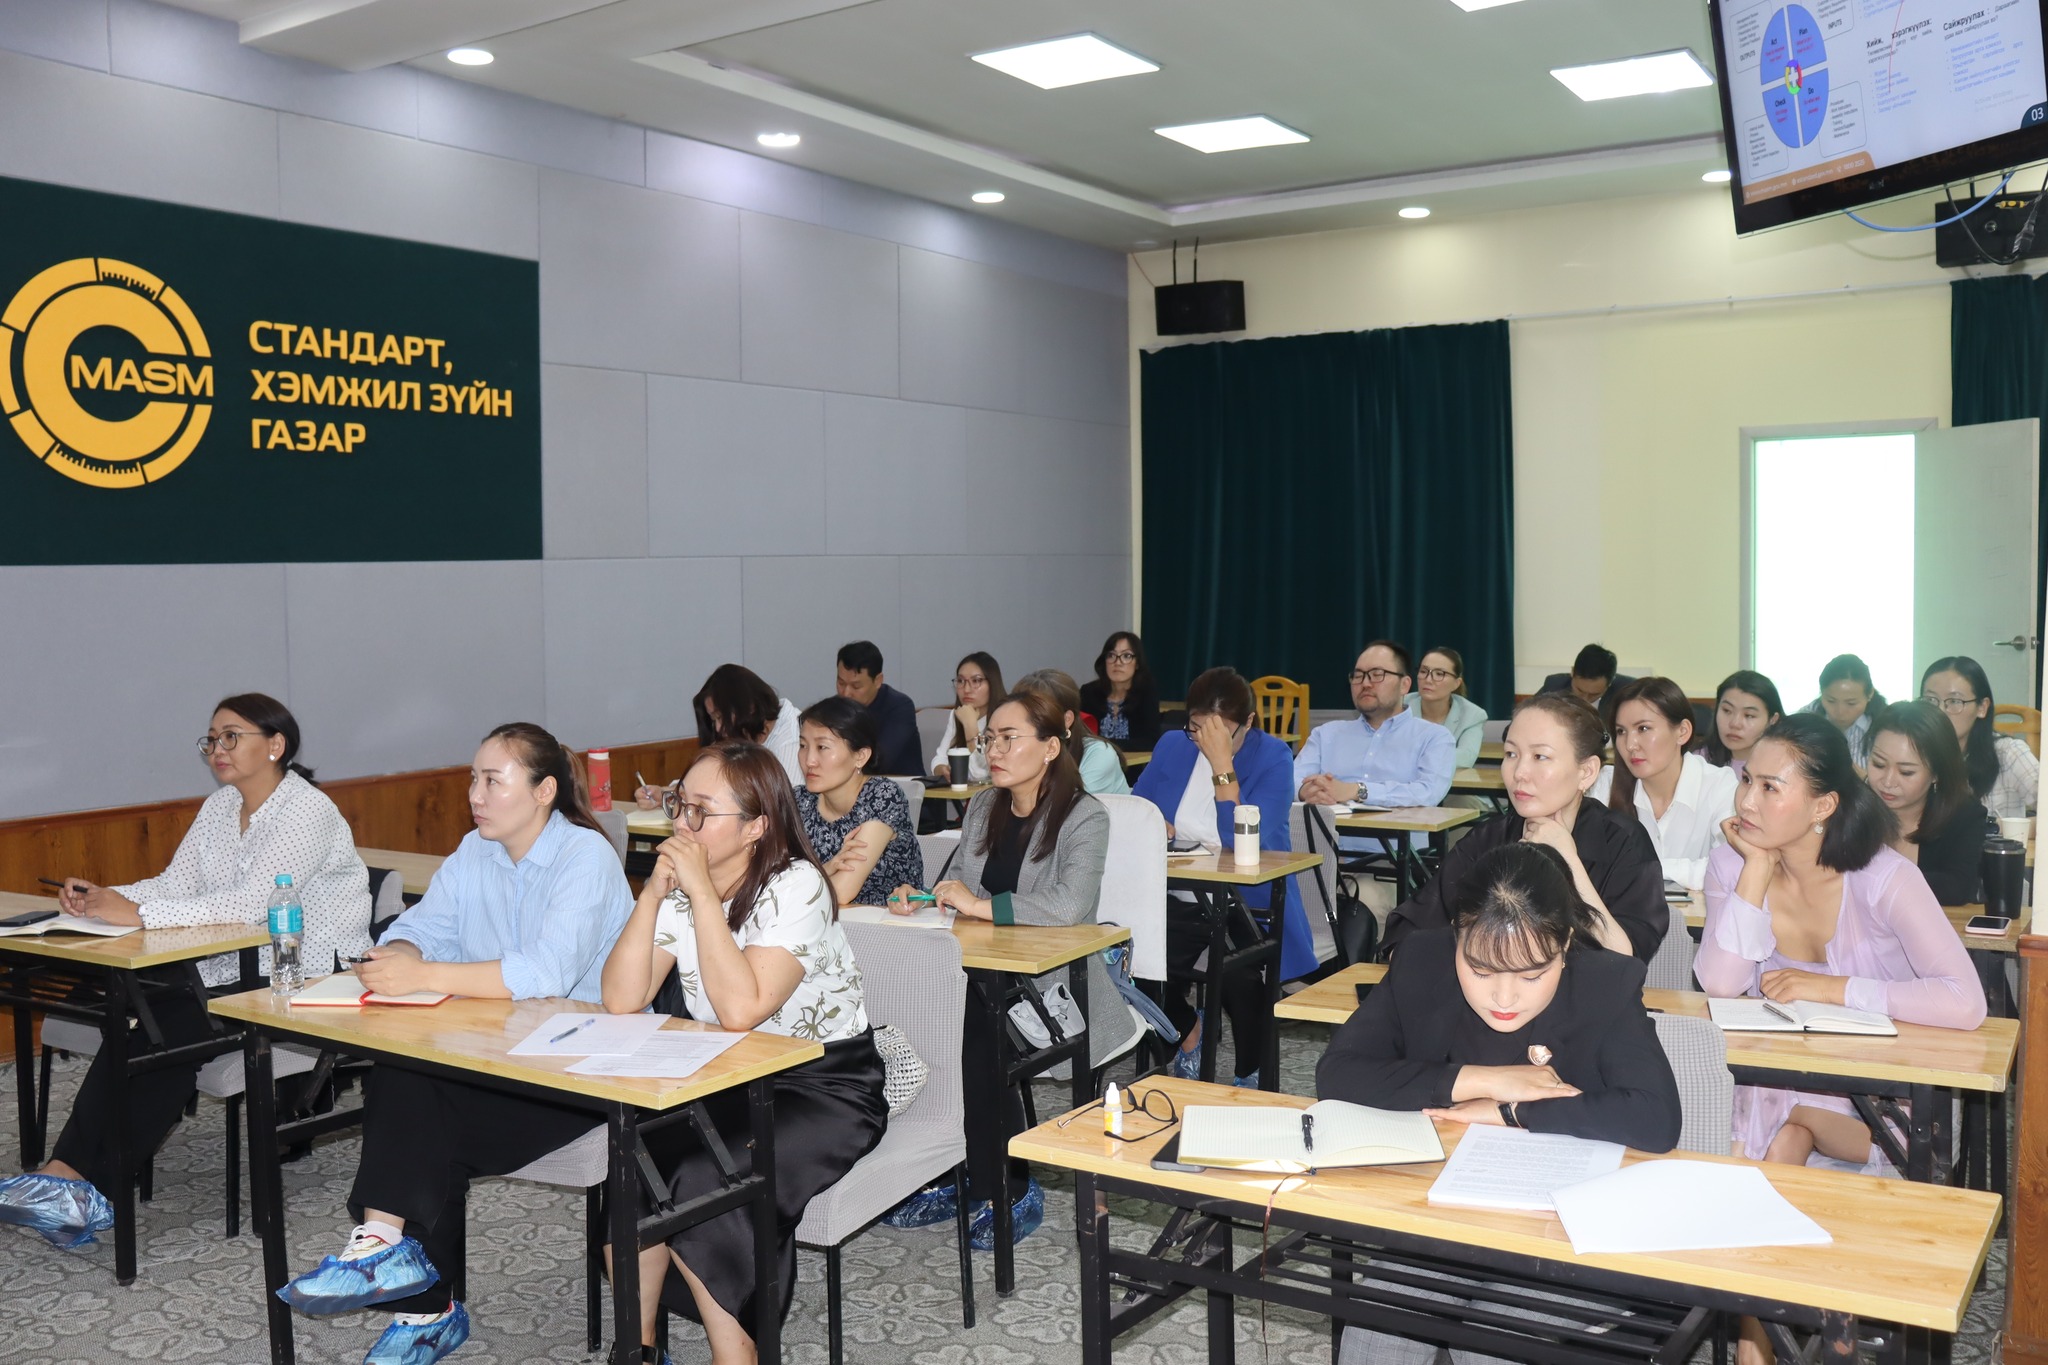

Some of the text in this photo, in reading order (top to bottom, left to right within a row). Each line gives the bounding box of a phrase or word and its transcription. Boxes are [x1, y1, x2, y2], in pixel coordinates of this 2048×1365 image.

[1943, 9, 1985, 31] Сайжруулах
[2031, 107, 2044, 122] 03
[248, 320, 452, 375] СТАНДАРТ,
[70, 355, 213, 397] MASM
[251, 370, 513, 418] ХЭМЖИЛ ЗҮЙН
[251, 419, 366, 453] ГАЗАР
